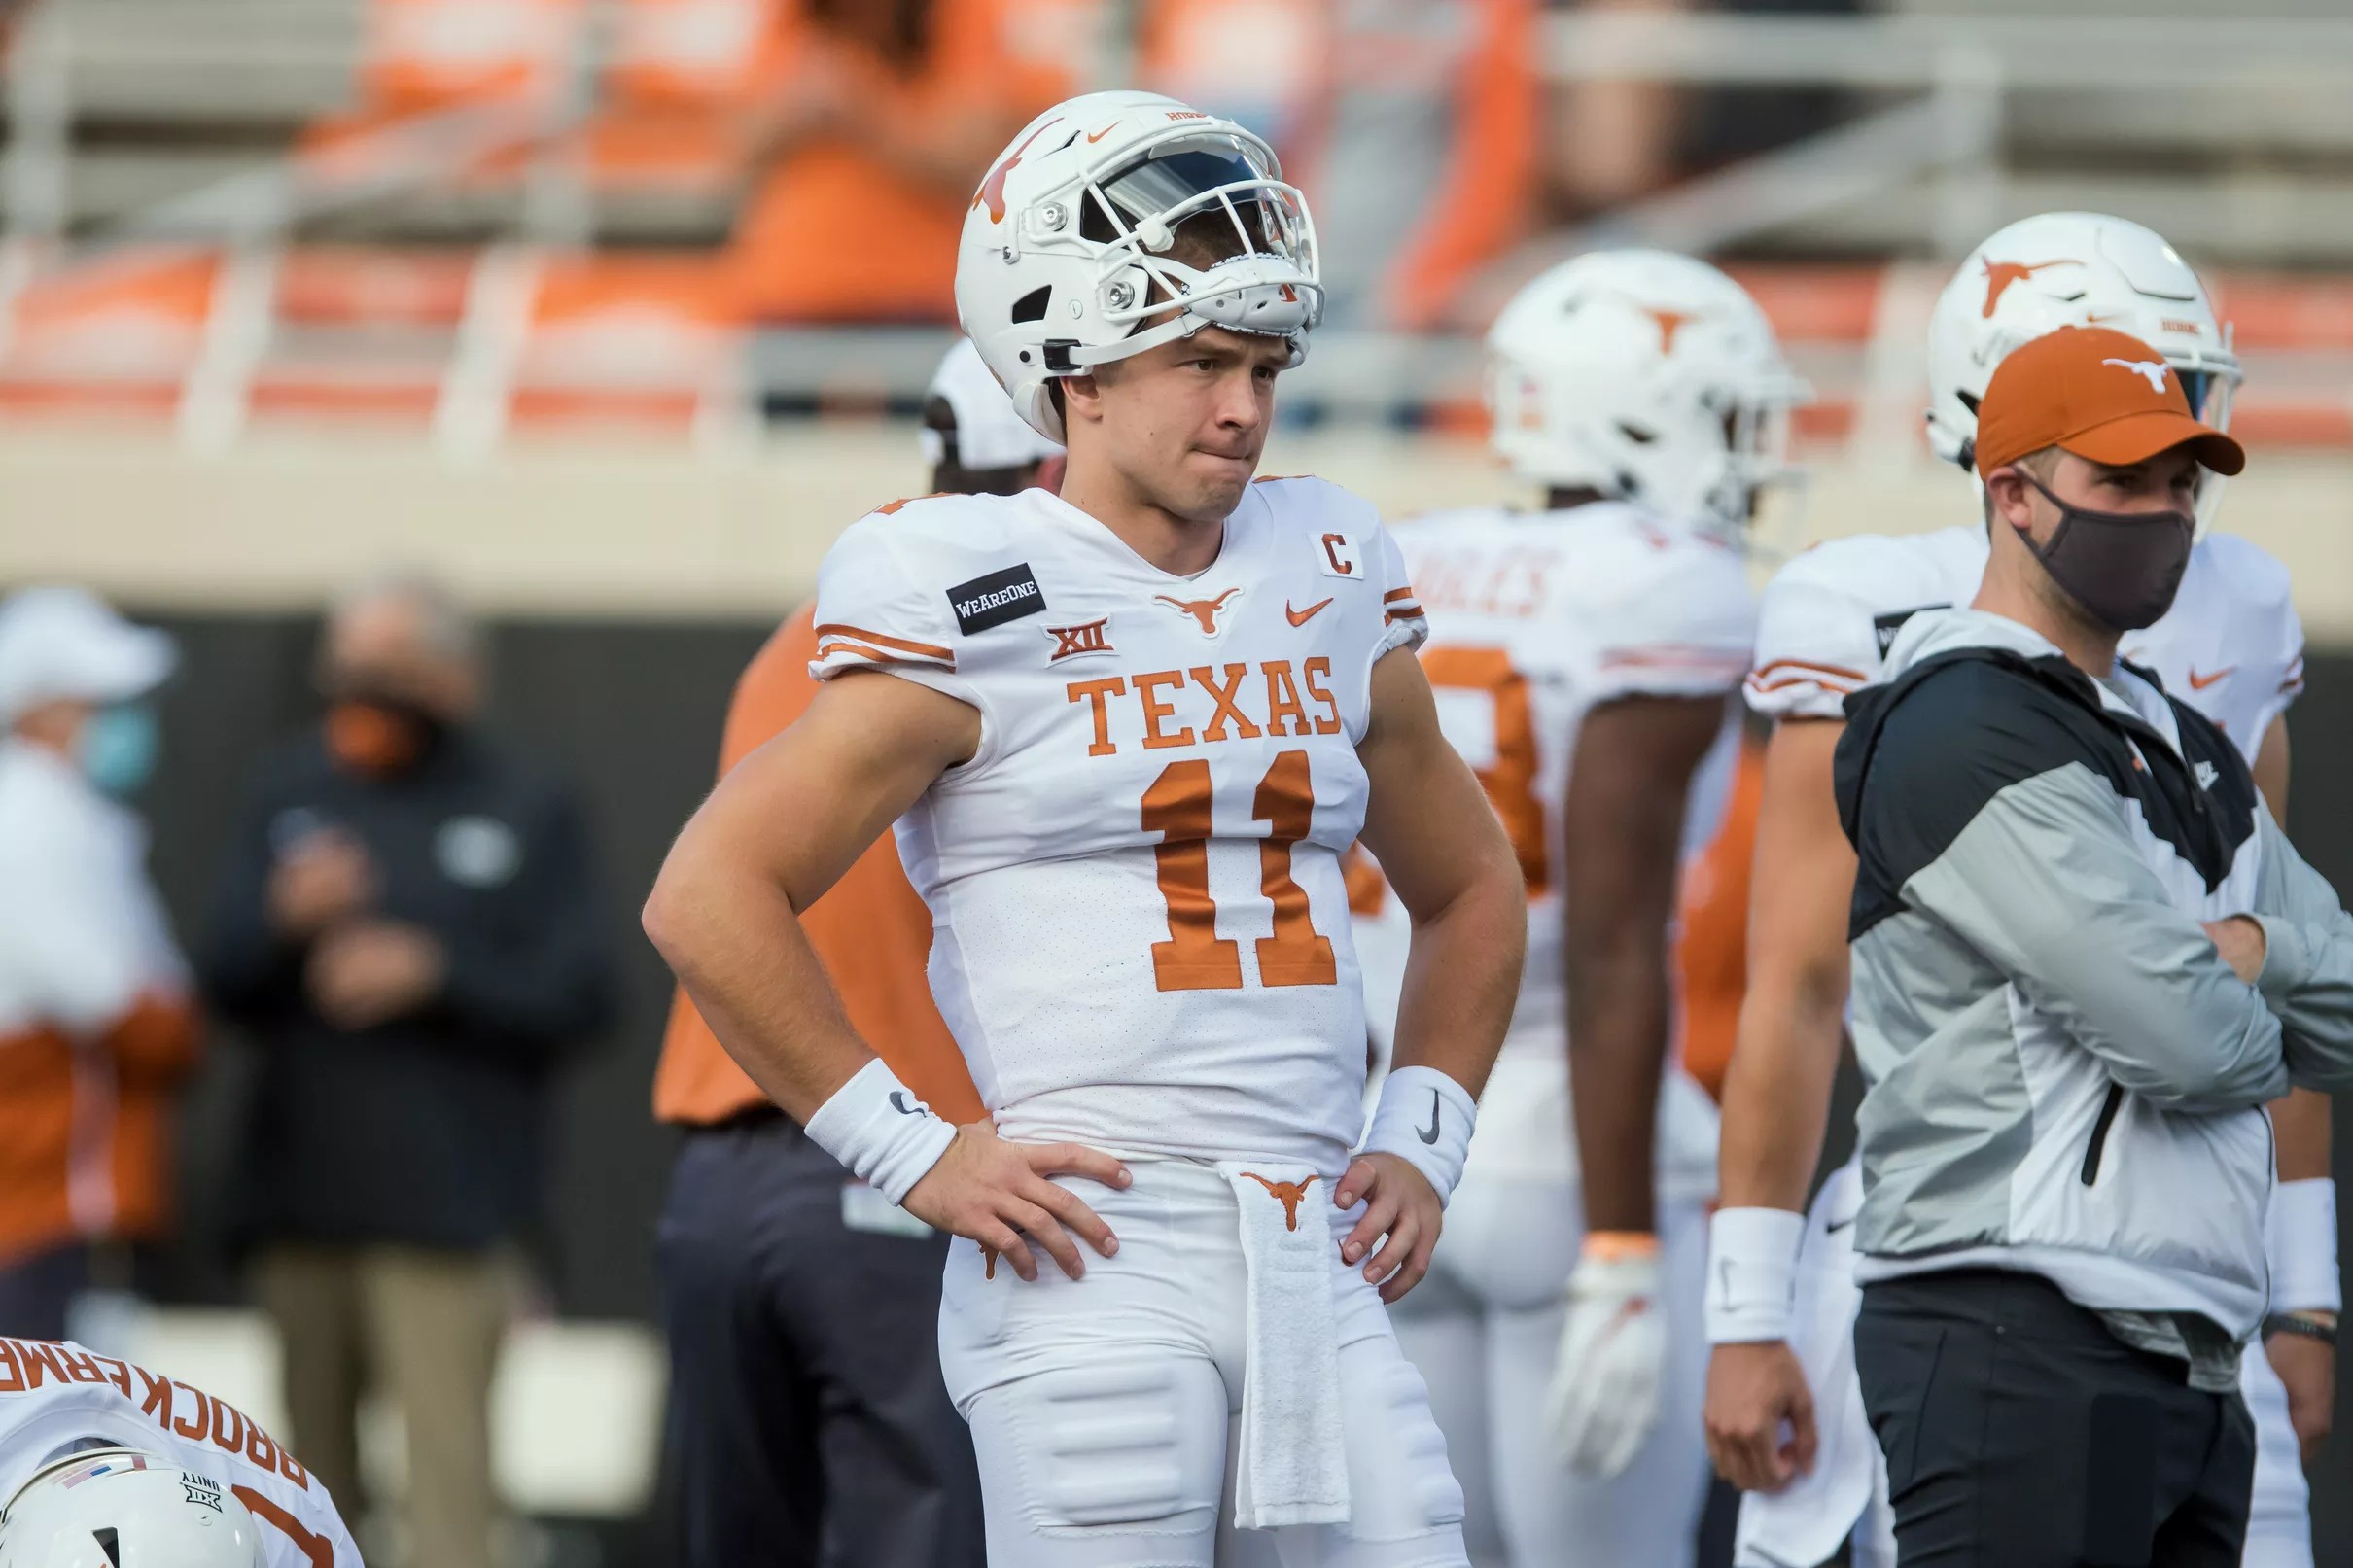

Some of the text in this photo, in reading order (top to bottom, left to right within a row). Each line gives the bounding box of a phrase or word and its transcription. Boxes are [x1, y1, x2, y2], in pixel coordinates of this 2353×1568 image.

[1321, 534, 1351, 574] C
[1046, 616, 1115, 662] XII
[1067, 657, 1341, 756] TEXAS
[1141, 749, 1337, 992] 11
[181, 1471, 221, 1492] UNITY
